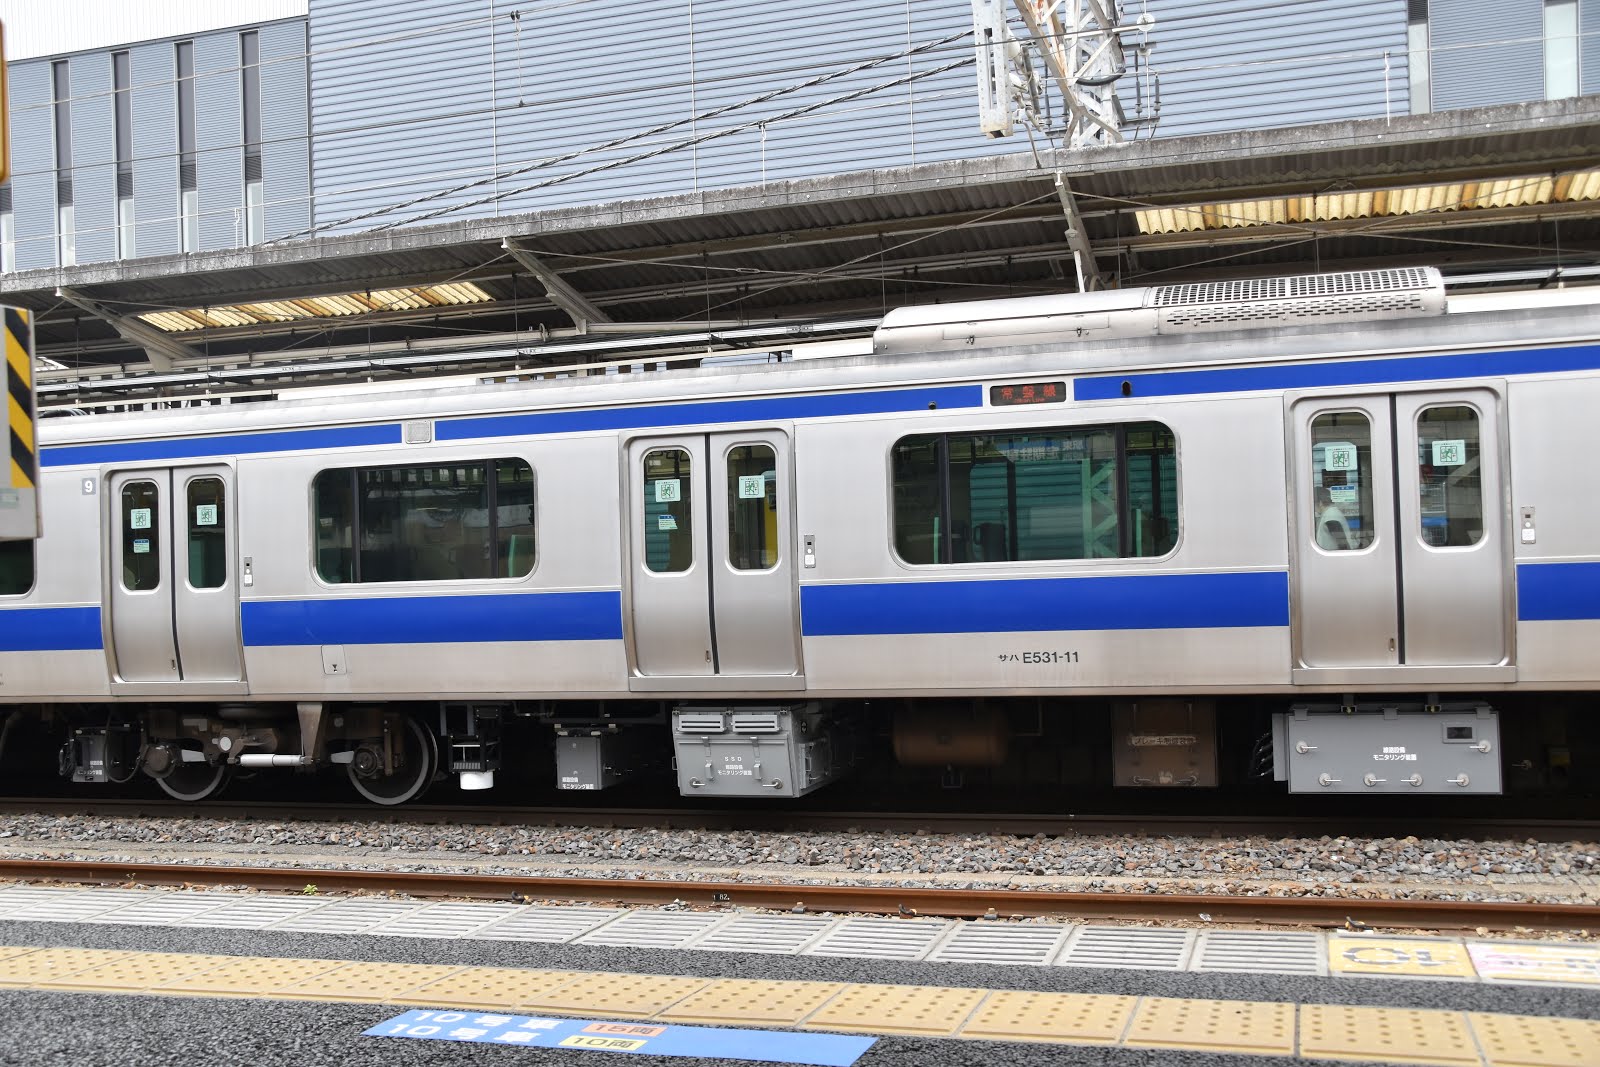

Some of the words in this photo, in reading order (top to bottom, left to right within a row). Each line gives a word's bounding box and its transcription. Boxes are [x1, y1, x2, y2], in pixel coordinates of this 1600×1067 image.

[84, 480, 94, 493] 9
[998, 654, 1020, 662] サハ
[1022, 651, 1079, 664] E531-11
[592, 1024, 660, 1036] 15両
[572, 1036, 638, 1049] 10両
